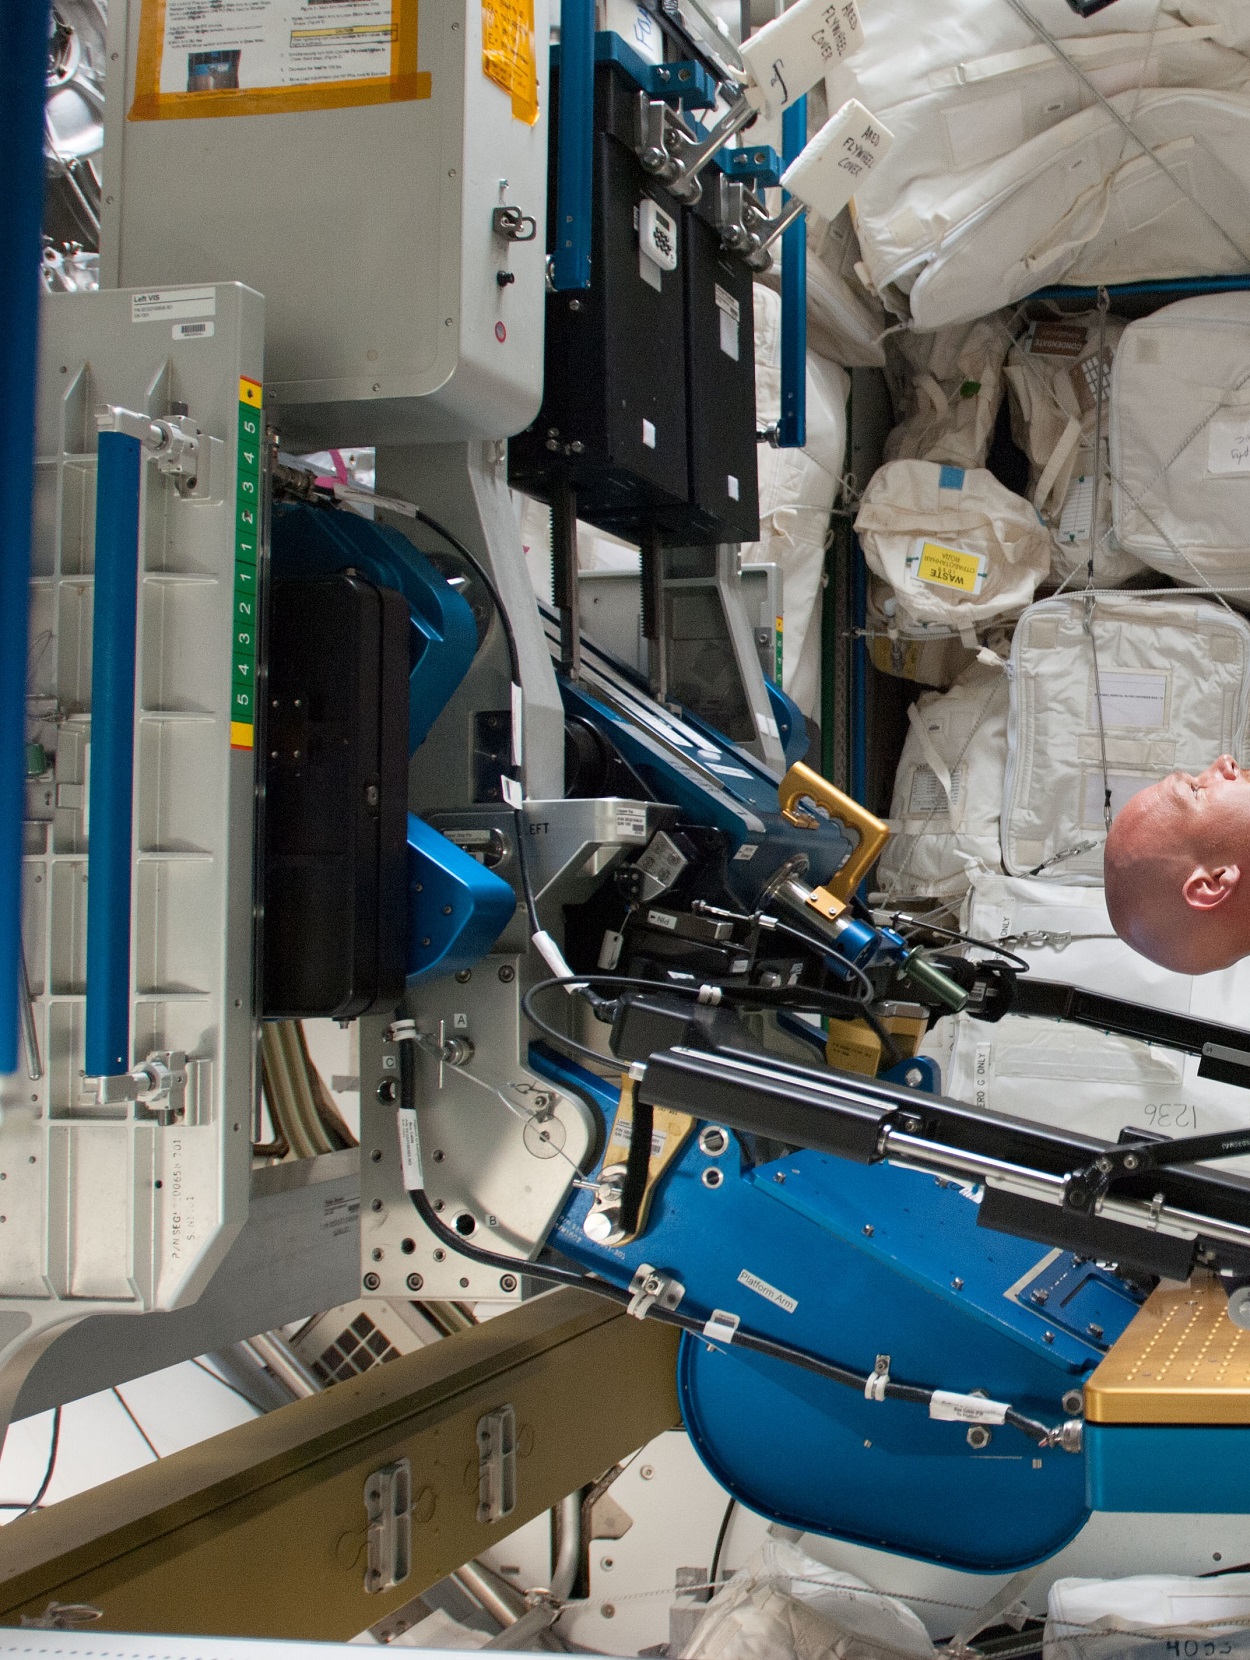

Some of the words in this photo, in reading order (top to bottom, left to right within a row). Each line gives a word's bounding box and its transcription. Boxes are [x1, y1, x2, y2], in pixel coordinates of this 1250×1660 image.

[811, 29, 833, 64] COVER
[838, 157, 863, 177] COVER
[133, 295, 147, 303] Left
[148, 294, 160, 302] VIS
[924, 555, 975, 574] ОТРАБОТАННАЯ
[941, 552, 961, 563] ВОДА
[929, 568, 964, 585] WASTE
[524, 823, 549, 836] EFT
[656, 915, 670, 926] PIN
[1000, 916, 1010, 937] ONLY
[457, 1015, 466, 1025] A
[385, 1058, 394, 1067] C
[977, 1053, 986, 1076] ONLY
[1144, 1103, 1197, 1129] 1236
[489, 1215, 497, 1226] B
[740, 1271, 775, 1298] Platform
[775, 1294, 794, 1310] Arm
